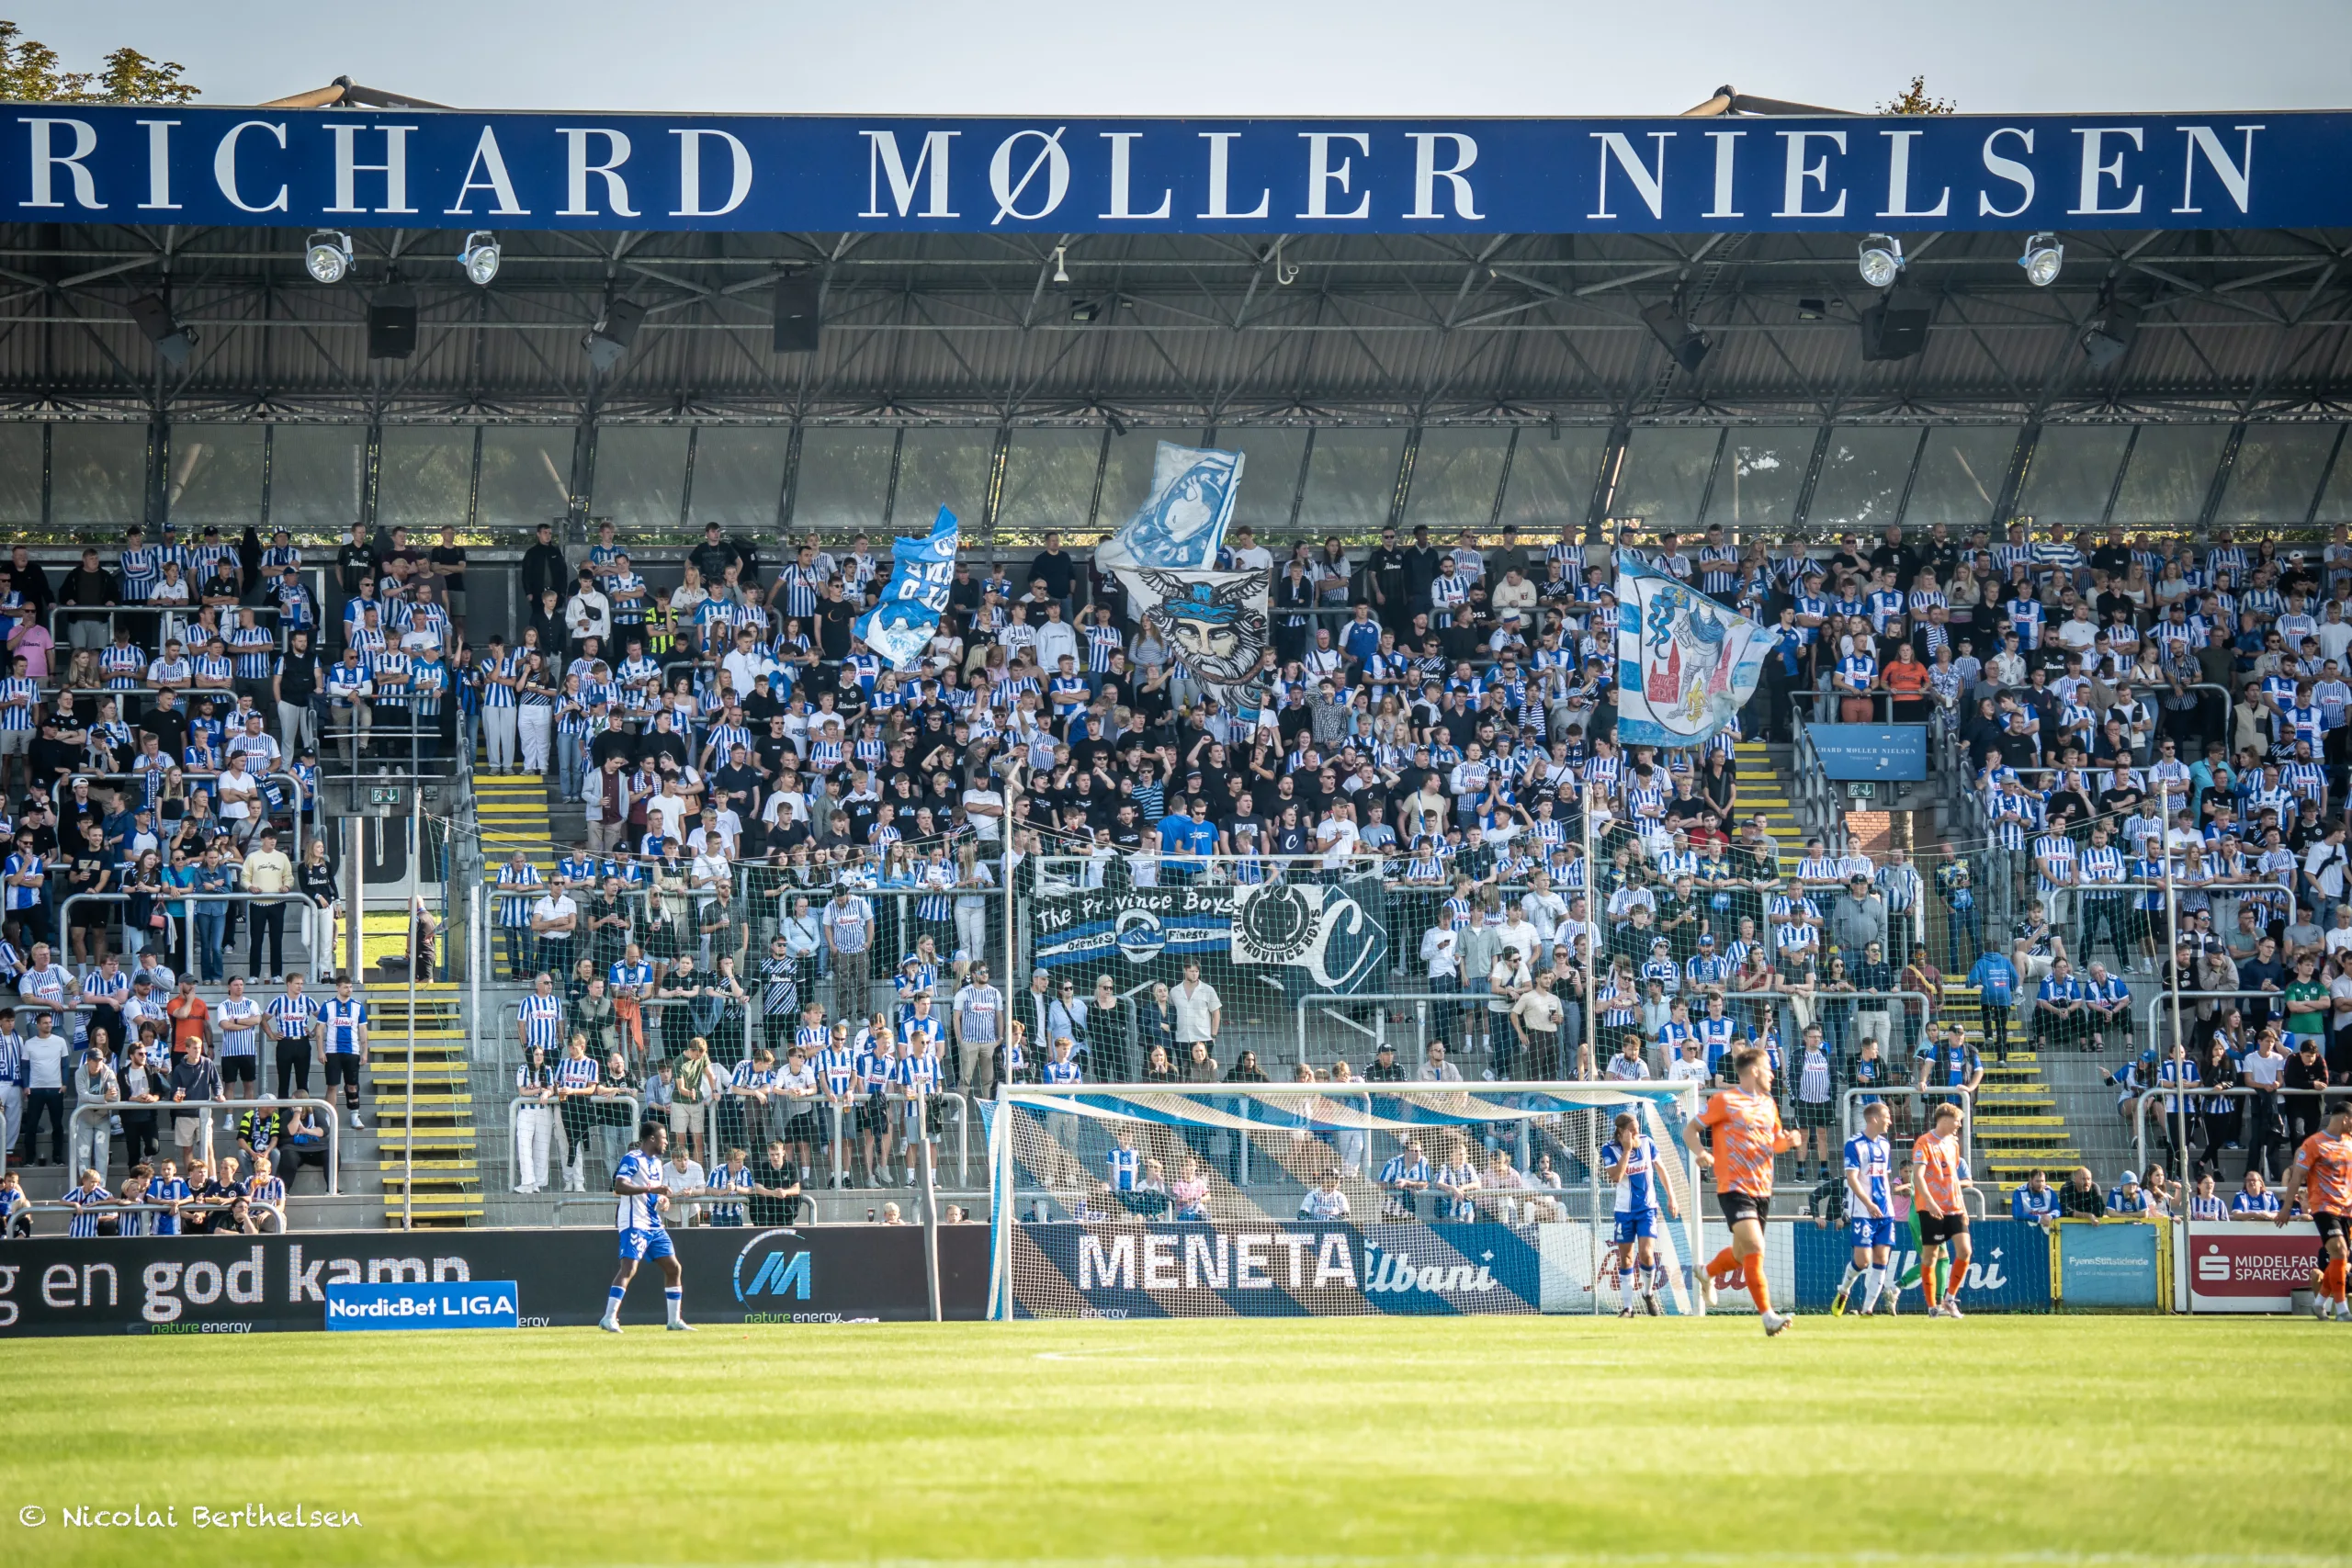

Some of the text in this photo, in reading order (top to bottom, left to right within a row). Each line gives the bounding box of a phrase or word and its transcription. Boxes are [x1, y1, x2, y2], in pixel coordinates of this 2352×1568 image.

[17, 117, 2266, 225] RICHARD MØLLER NIELSEN
[1036, 891, 1235, 932] The Prvince Boys
[1237, 936, 1305, 964] PROVINCE
[1301, 908, 1321, 948] BOYS
[1261, 941, 1285, 950] YOUTH
[867, 1075, 887, 1083] Albani
[1079, 1233, 1357, 1290] MENETA
[2235, 1256, 2319, 1268] MIDDELFAR
[42, 1262, 118, 1307] en
[142, 1245, 264, 1323] god
[329, 1295, 514, 1317] NordicBet LIGA
[519, 1316, 549, 1327] ergy
[744, 1312, 791, 1323] nature
[152, 1322, 199, 1334] nature
